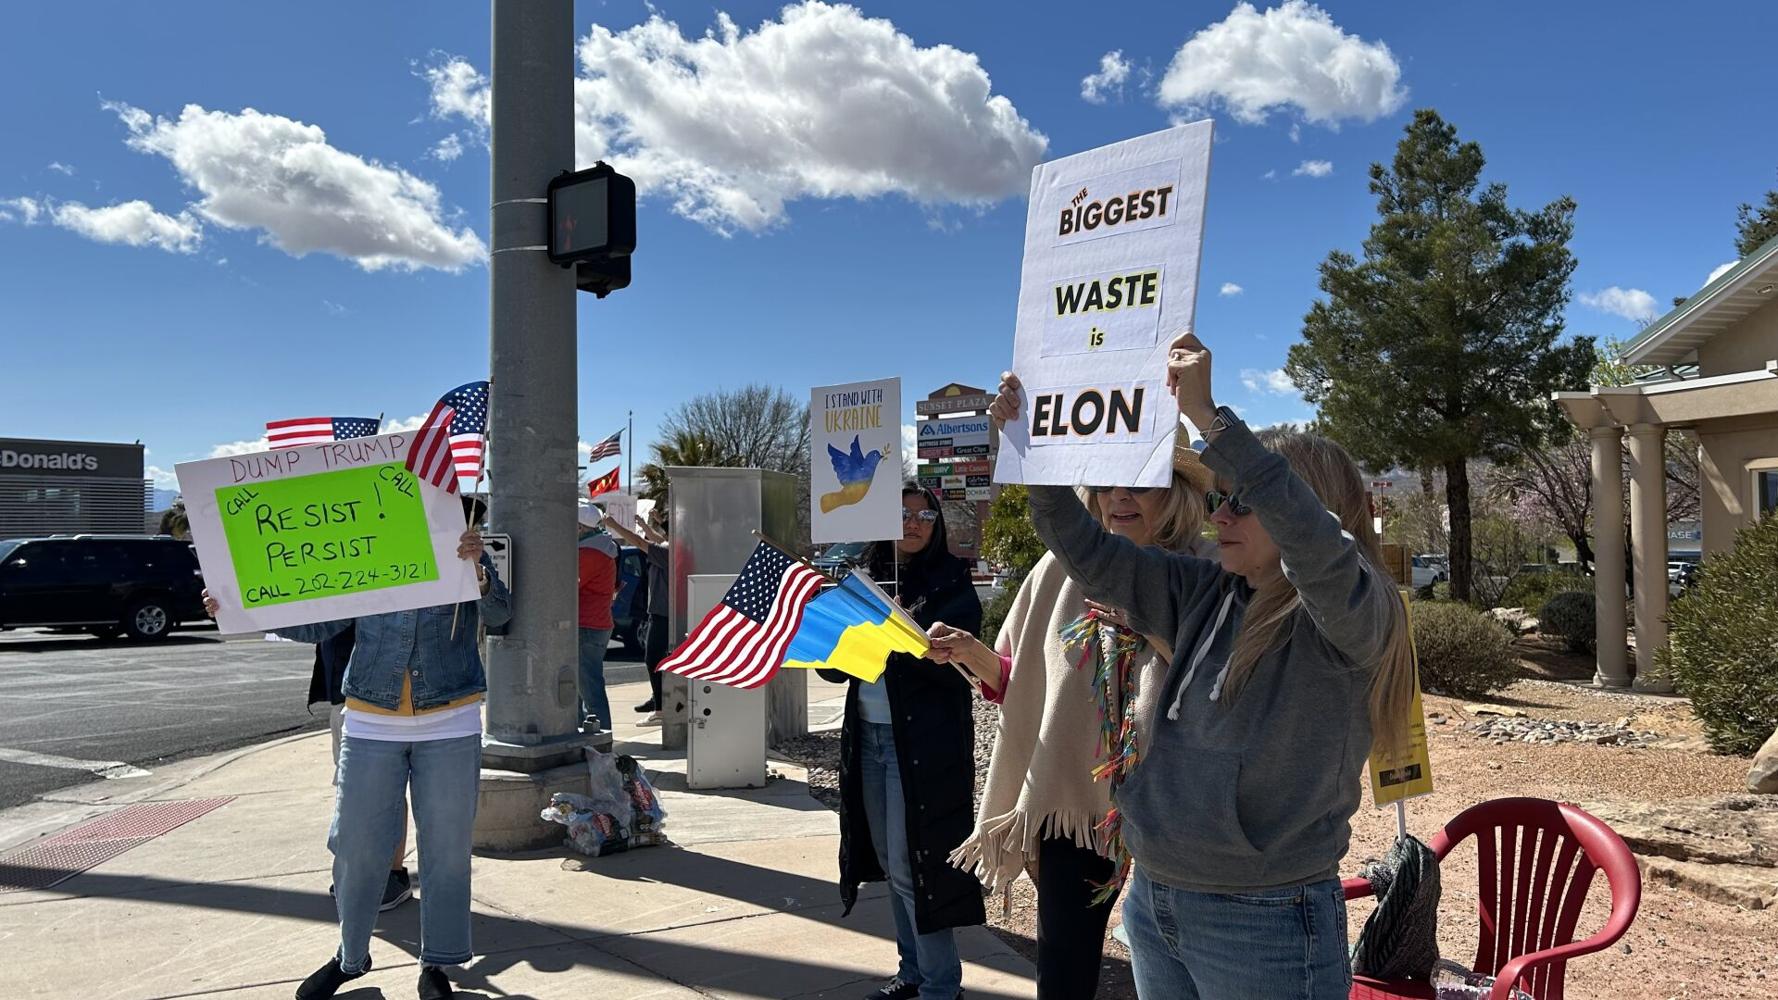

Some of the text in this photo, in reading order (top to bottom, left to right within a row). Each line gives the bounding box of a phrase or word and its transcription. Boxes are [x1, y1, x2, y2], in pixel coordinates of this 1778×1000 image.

[1058, 185, 1174, 236] BIGGEST
[1071, 186, 1089, 208] THE
[1055, 271, 1159, 316] WASTE
[1090, 327, 1105, 347] is
[825, 388, 883, 409] I STAND WITH
[918, 397, 988, 412] SUNSET PLAZA
[825, 404, 883, 433] UKRAINE
[1031, 387, 1145, 438] ELON
[936, 422, 989, 435] Albertsons
[0, 449, 99, 470] Donald's
[230, 434, 406, 484] DUMP TRUMP
[379, 465, 414, 498] CALL
[227, 489, 259, 516] CALL
[255, 500, 363, 536] RESIST
[1667, 531, 1692, 539] ASE
[266, 535, 377, 573] PERSIST
[245, 584, 291, 604] CALL
